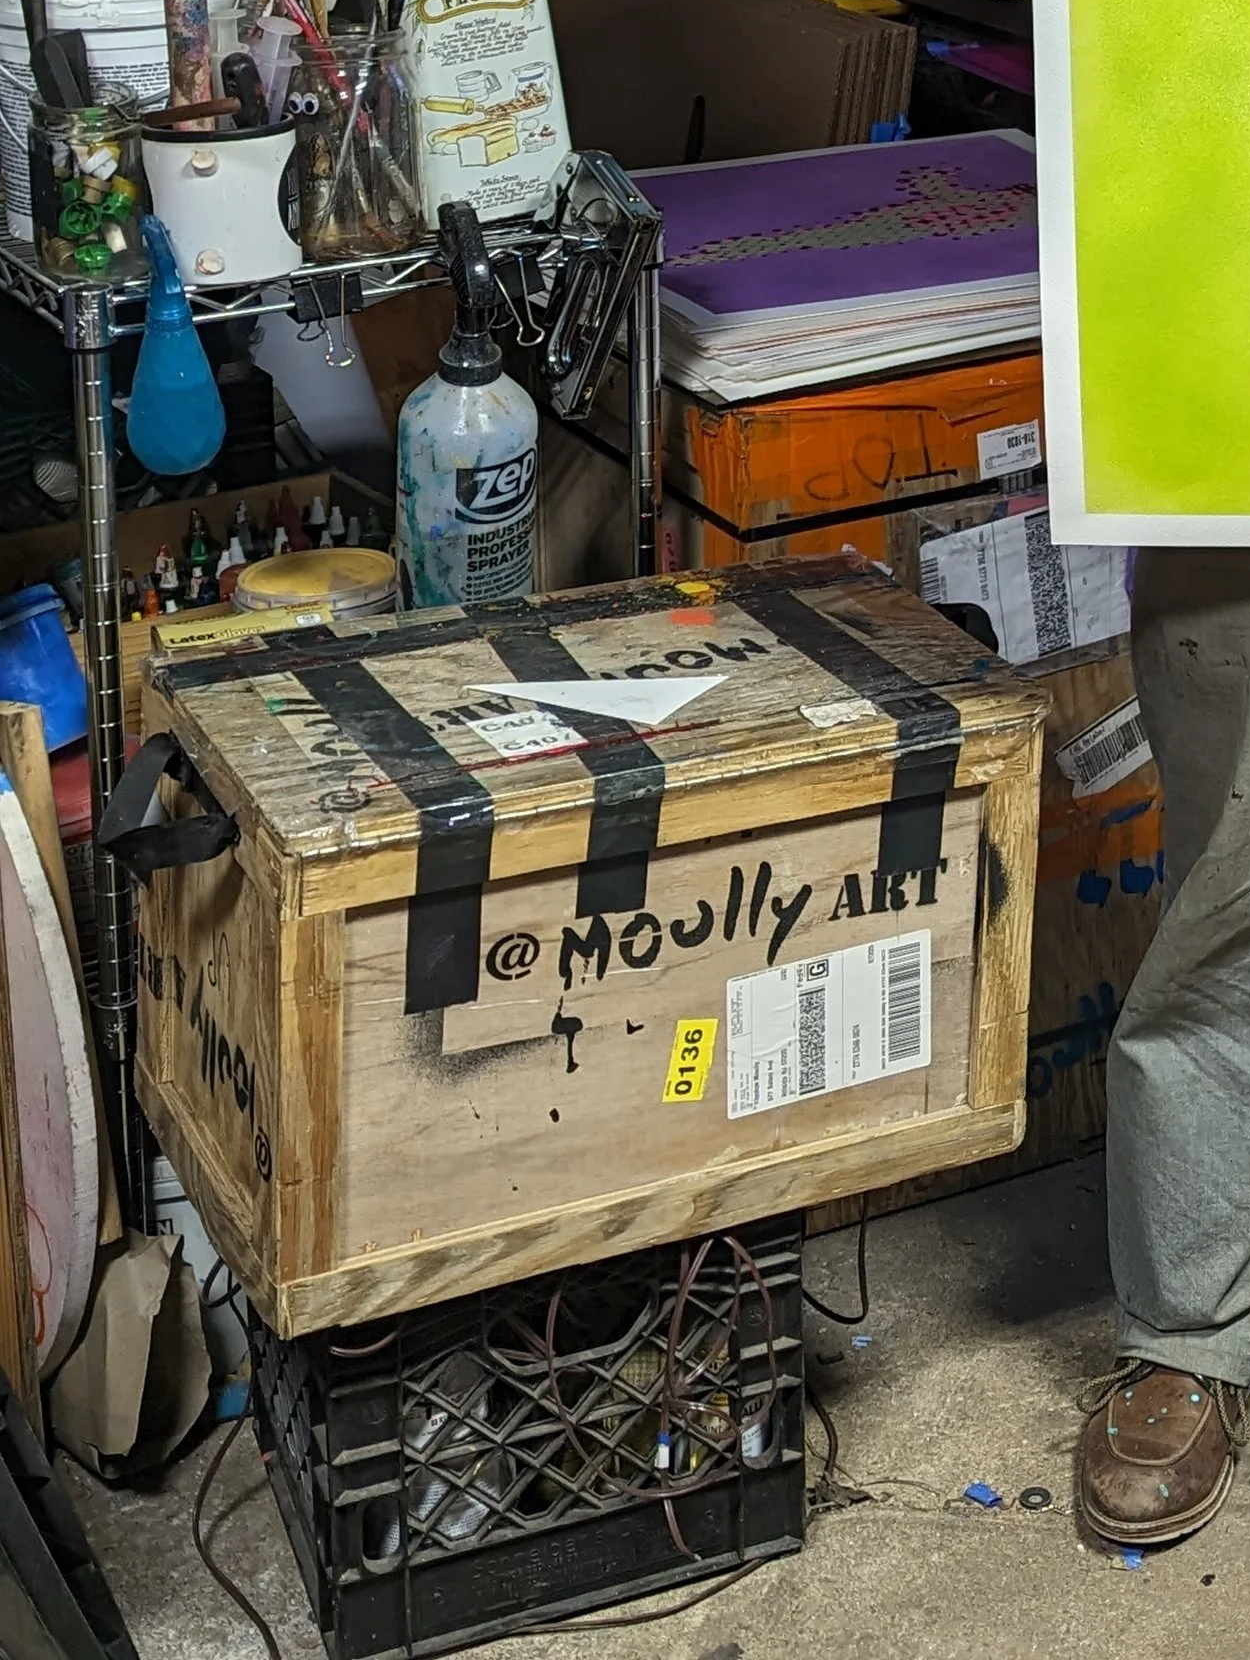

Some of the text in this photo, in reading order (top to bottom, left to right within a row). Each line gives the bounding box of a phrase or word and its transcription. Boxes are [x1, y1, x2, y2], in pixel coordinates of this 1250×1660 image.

[466, 539, 530, 573] SPRAYER
[828, 857, 947, 922] ART
[674, 1028, 703, 1096] 0136
